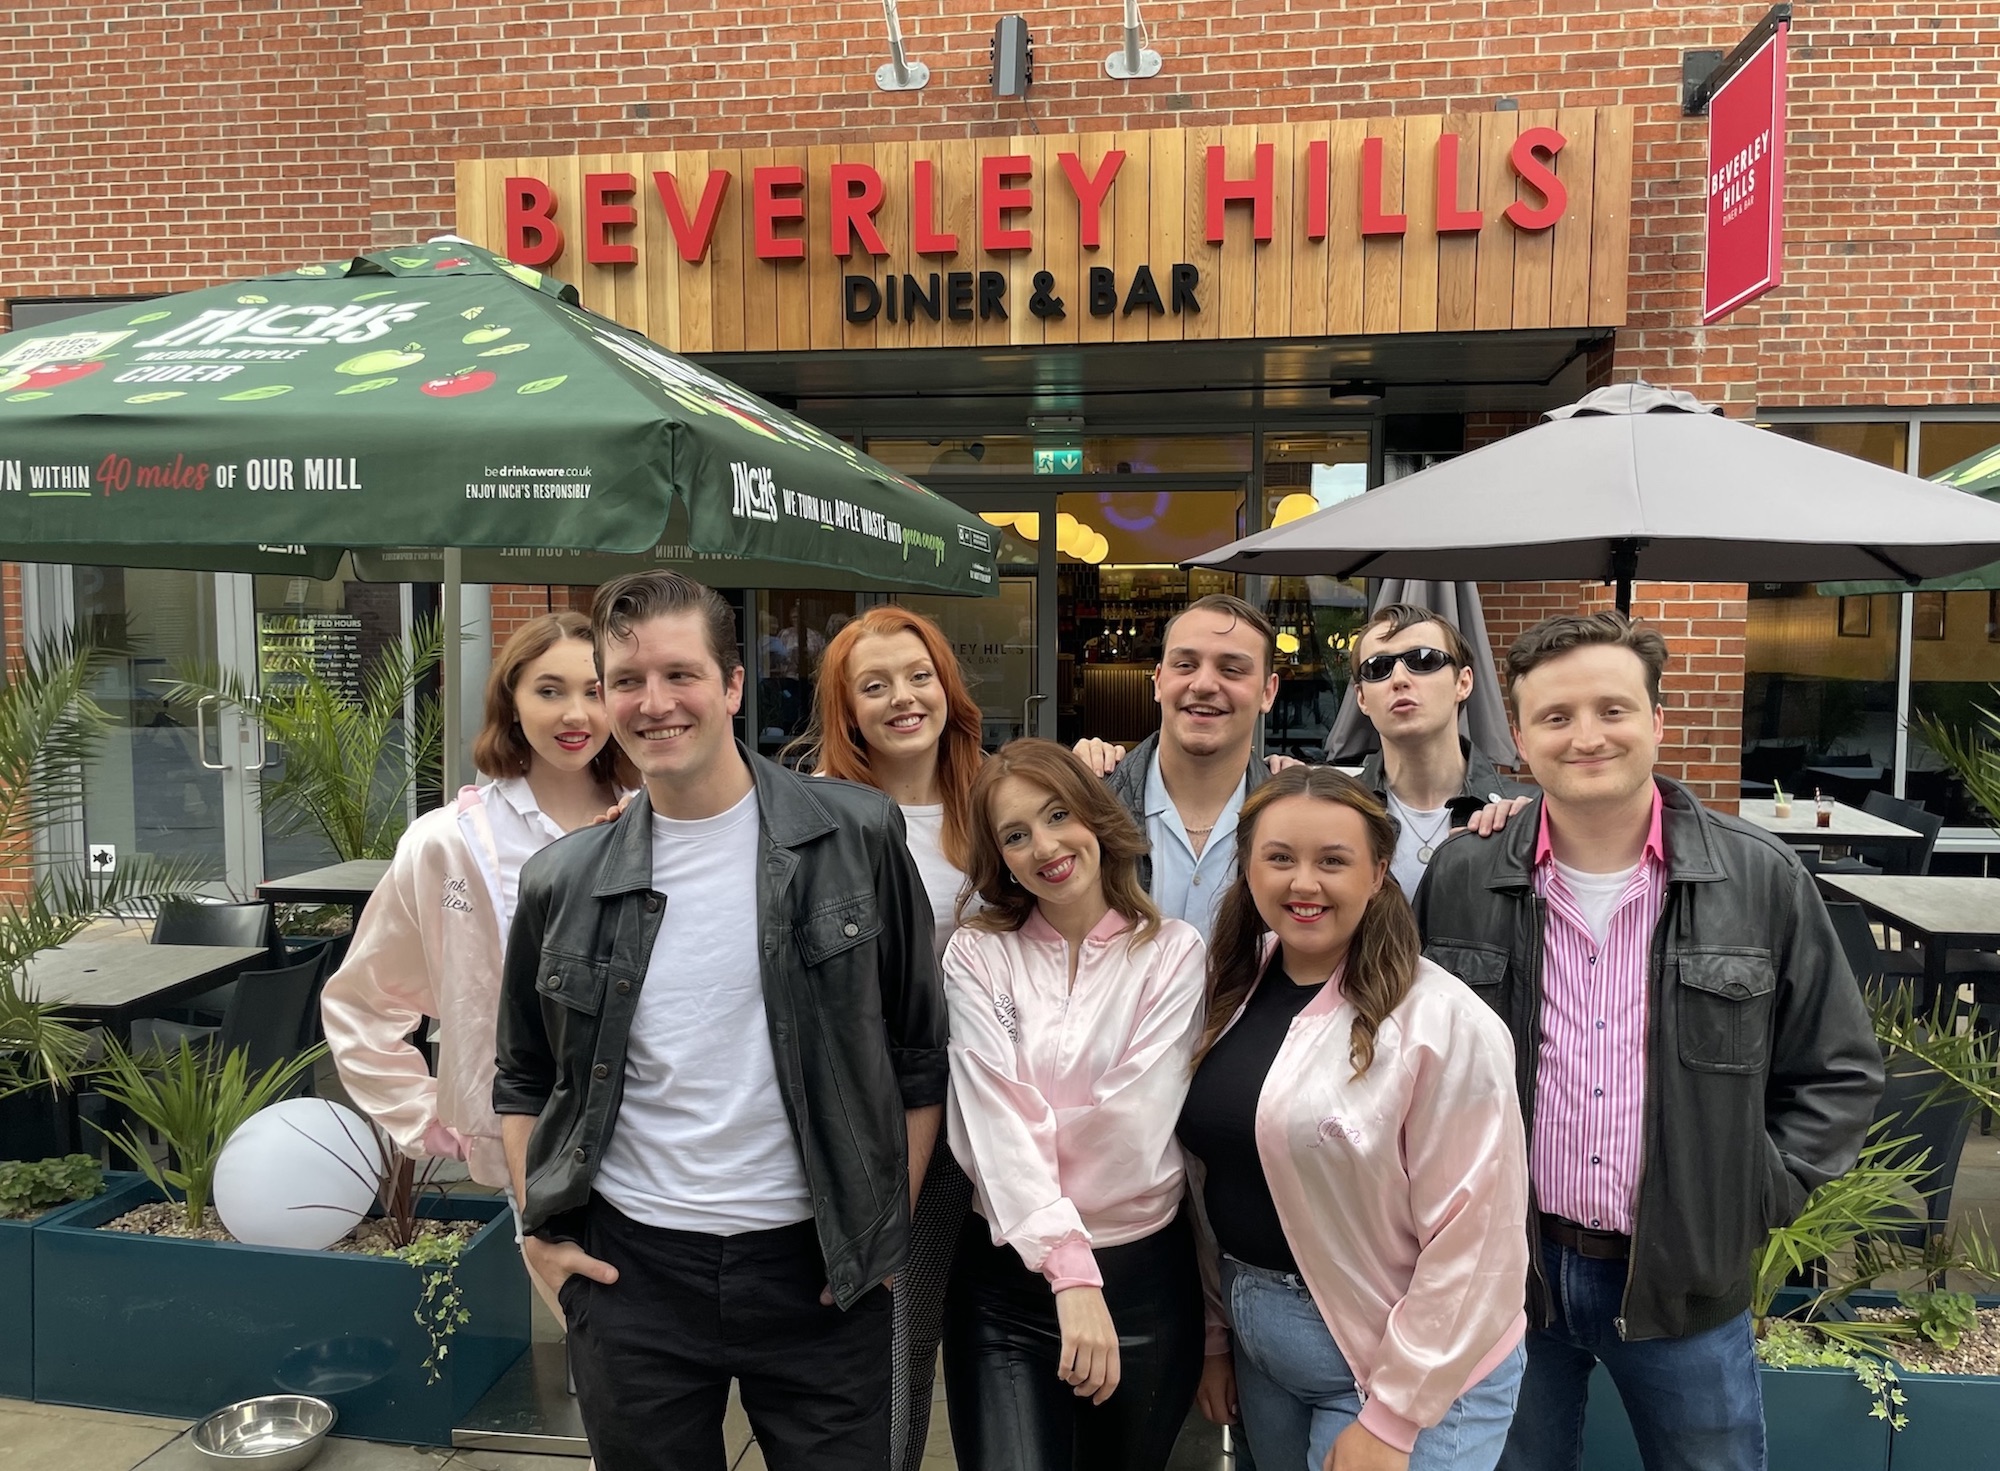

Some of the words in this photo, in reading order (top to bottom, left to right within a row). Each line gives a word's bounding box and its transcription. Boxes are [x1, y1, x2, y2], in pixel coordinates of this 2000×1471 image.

[1711, 129, 1769, 196] BEVERLEY
[505, 149, 1126, 267] BEVERLEY
[1206, 127, 1567, 244] HILLS
[1723, 168, 1755, 212] HILLS
[1722, 207, 1738, 226] DINER
[1744, 195, 1755, 210] BAR
[844, 270, 1009, 324] DINER
[1029, 270, 1066, 318] &
[1089, 263, 1201, 316] BAR
[13, 348, 87, 362] APPLES
[21, 341, 102, 355] BRITISH
[134, 349, 228, 361] MEDIUM
[226, 349, 308, 360] APPLE
[113, 364, 246, 382] CIDER
[0, 460, 22, 491] N
[29, 466, 90, 489] WITHIN
[96, 453, 132, 496] 40
[136, 453, 210, 491] miles
[216, 465, 238, 488] OF
[246, 459, 294, 491] OUR
[304, 458, 362, 490] MILL
[466, 484, 496, 498] ENJOY
[498, 484, 530, 498] INCH'S
[533, 484, 592, 498] RESPONSIBLY
[782, 488, 797, 516] WE
[797, 492, 819, 522] TURN
[820, 499, 834, 525] ALL
[835, 499, 860, 532] APPLE
[859, 507, 887, 541] WASTE
[887, 520, 902, 544] INTO
[902, 527, 923, 561] green
[923, 531, 945, 567] energy
[334, 619, 362, 627] HOURS
